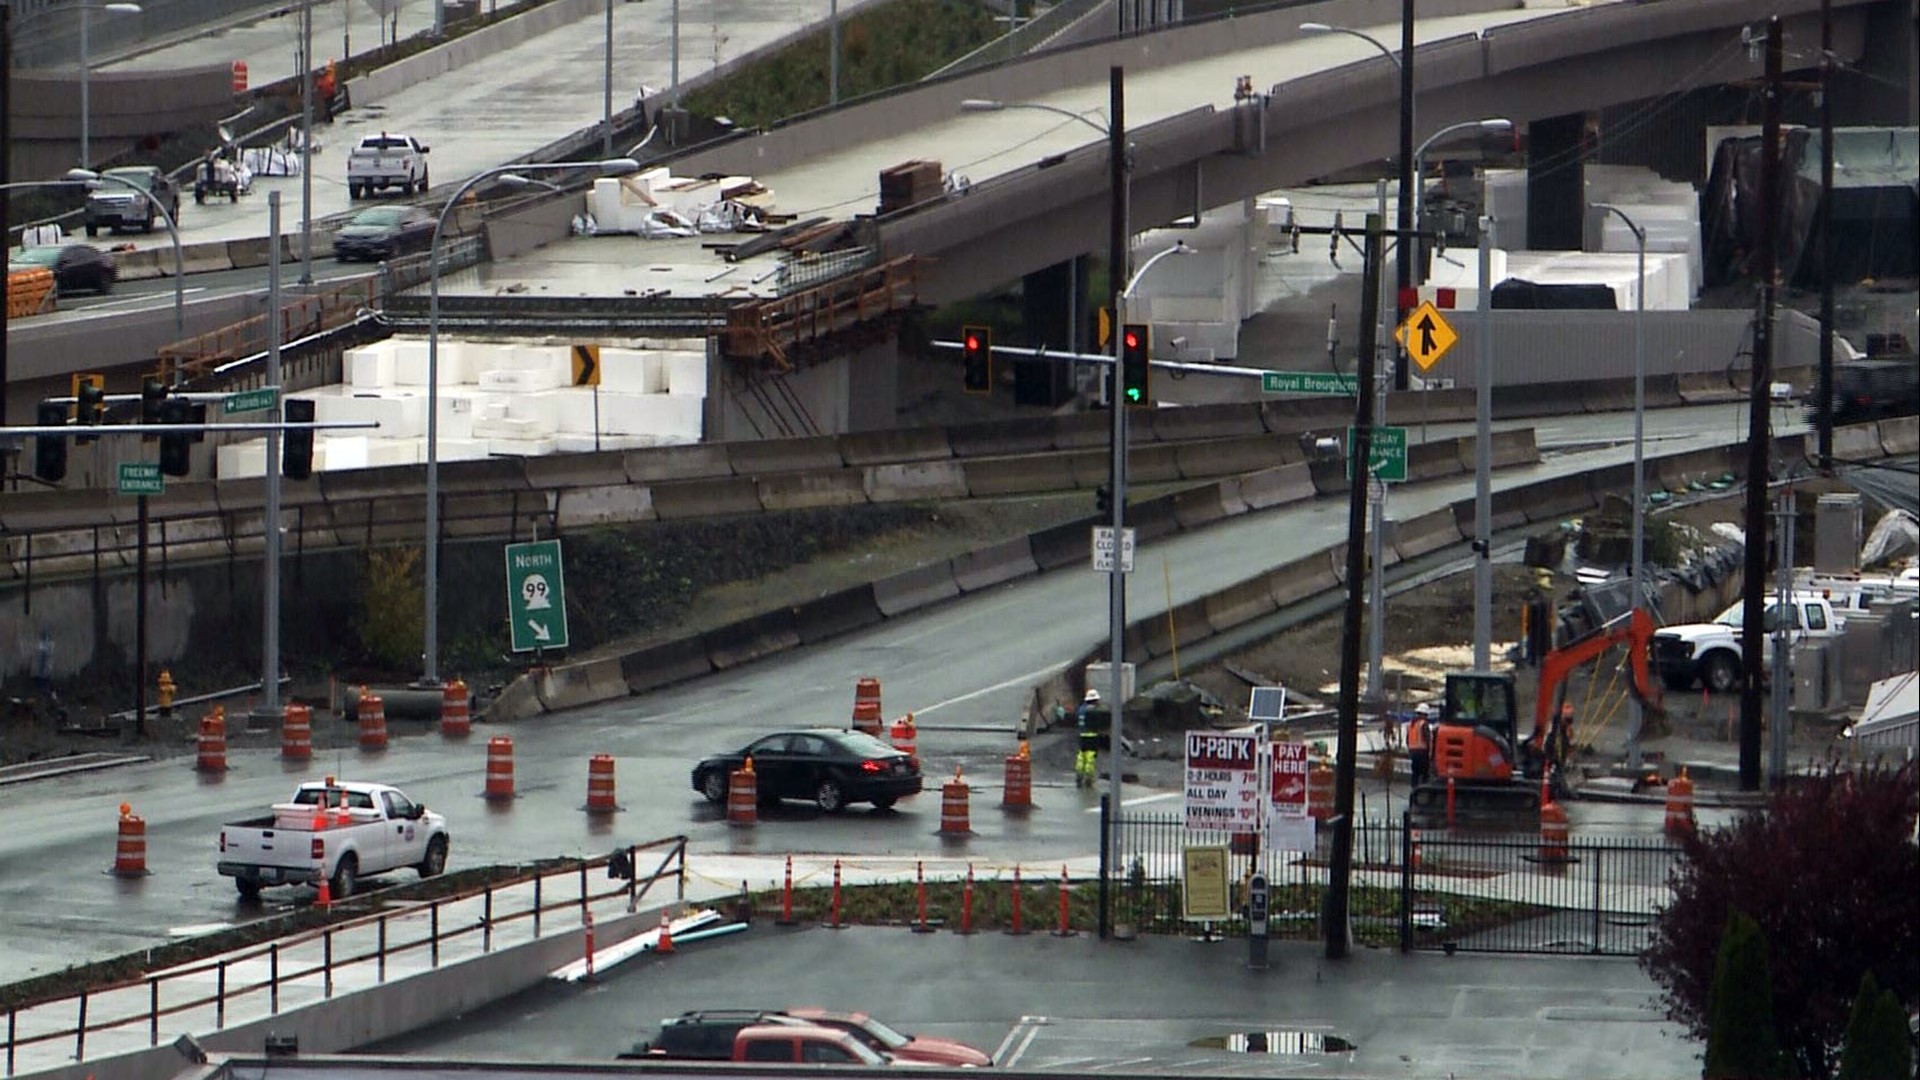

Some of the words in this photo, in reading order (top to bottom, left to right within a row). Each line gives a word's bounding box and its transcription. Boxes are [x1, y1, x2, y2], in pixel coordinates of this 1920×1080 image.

[1270, 376, 1300, 390] Royal
[124, 467, 159, 478] FREEWAY
[121, 480, 161, 490] ENTRANCE
[515, 554, 552, 568] NORTH
[526, 582, 546, 598] 99
[1279, 745, 1302, 758] PAY
[1274, 759, 1305, 773] HERE
[1204, 772, 1232, 782] HOURS
[1187, 788, 1204, 799] ALL
[1207, 789, 1227, 799] DAY
[1186, 806, 1236, 817] EVENINGS
